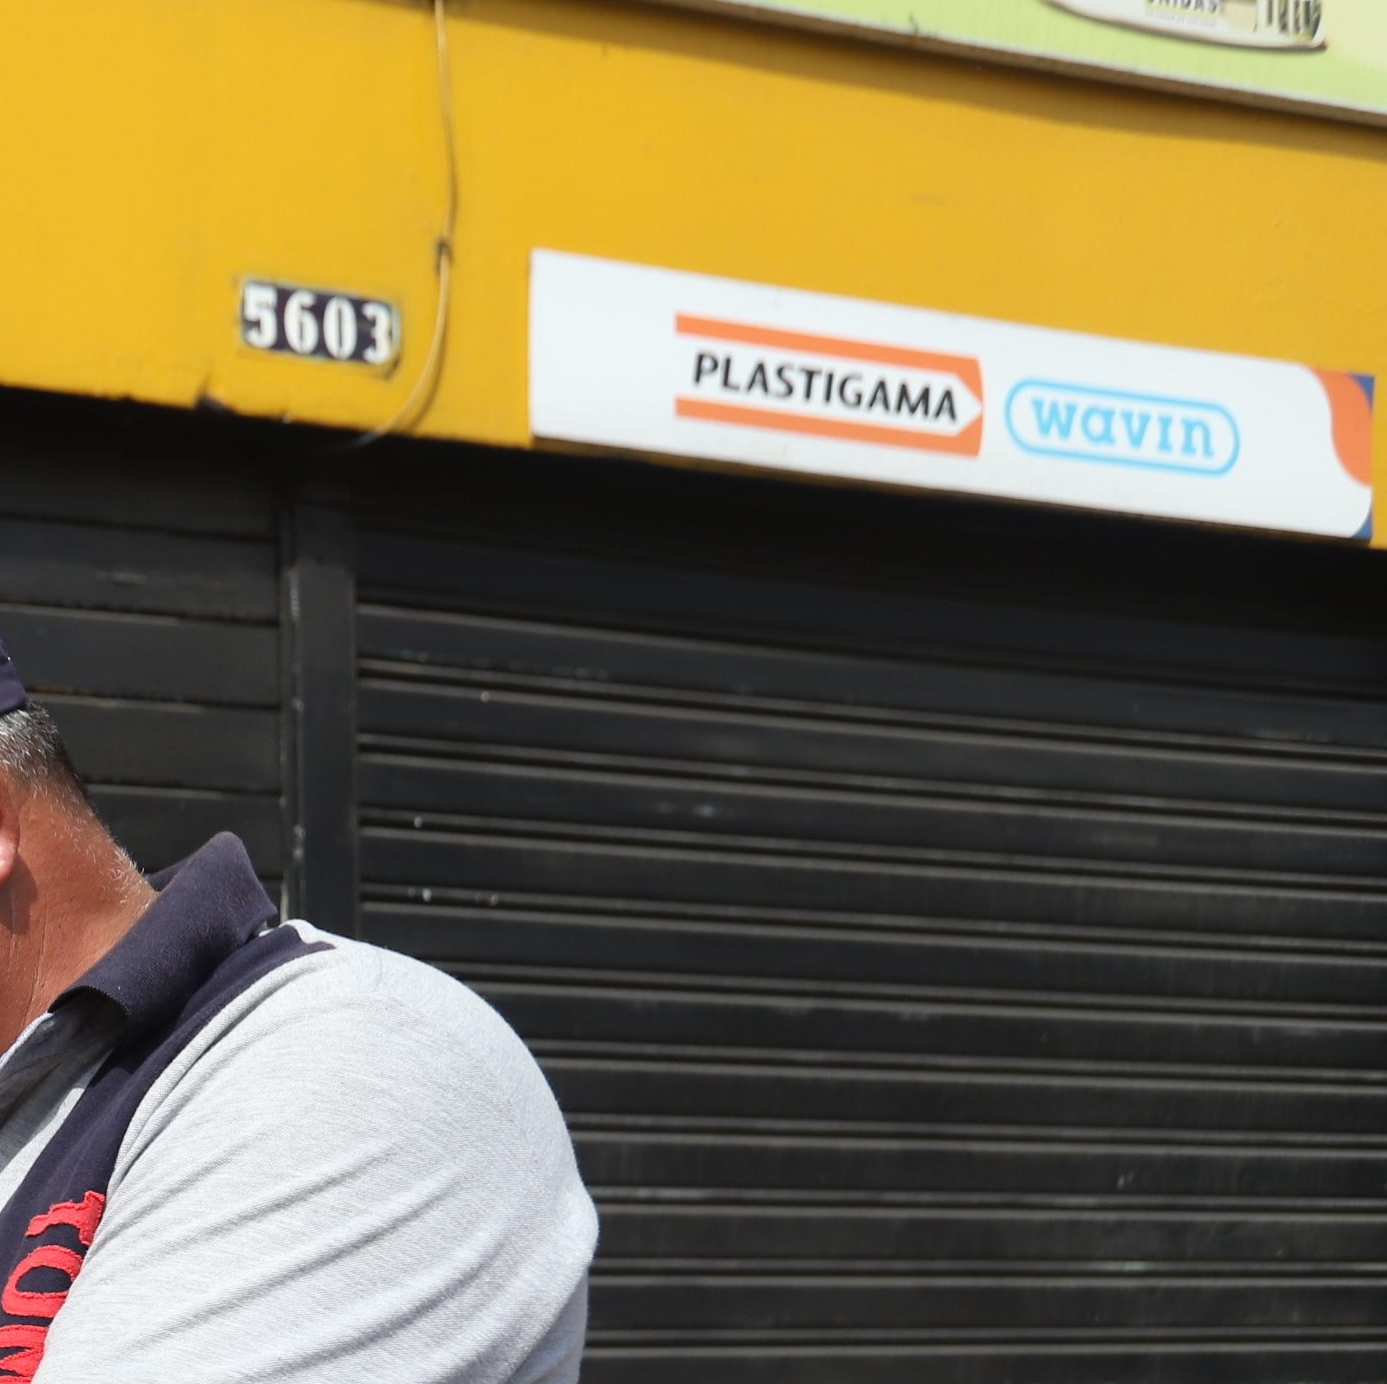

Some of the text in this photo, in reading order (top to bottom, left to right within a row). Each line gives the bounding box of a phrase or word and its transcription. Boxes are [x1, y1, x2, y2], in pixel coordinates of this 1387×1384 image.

[242, 281, 393, 365] 5603
[692, 350, 1216, 460] PLASTIGAMA wavin
